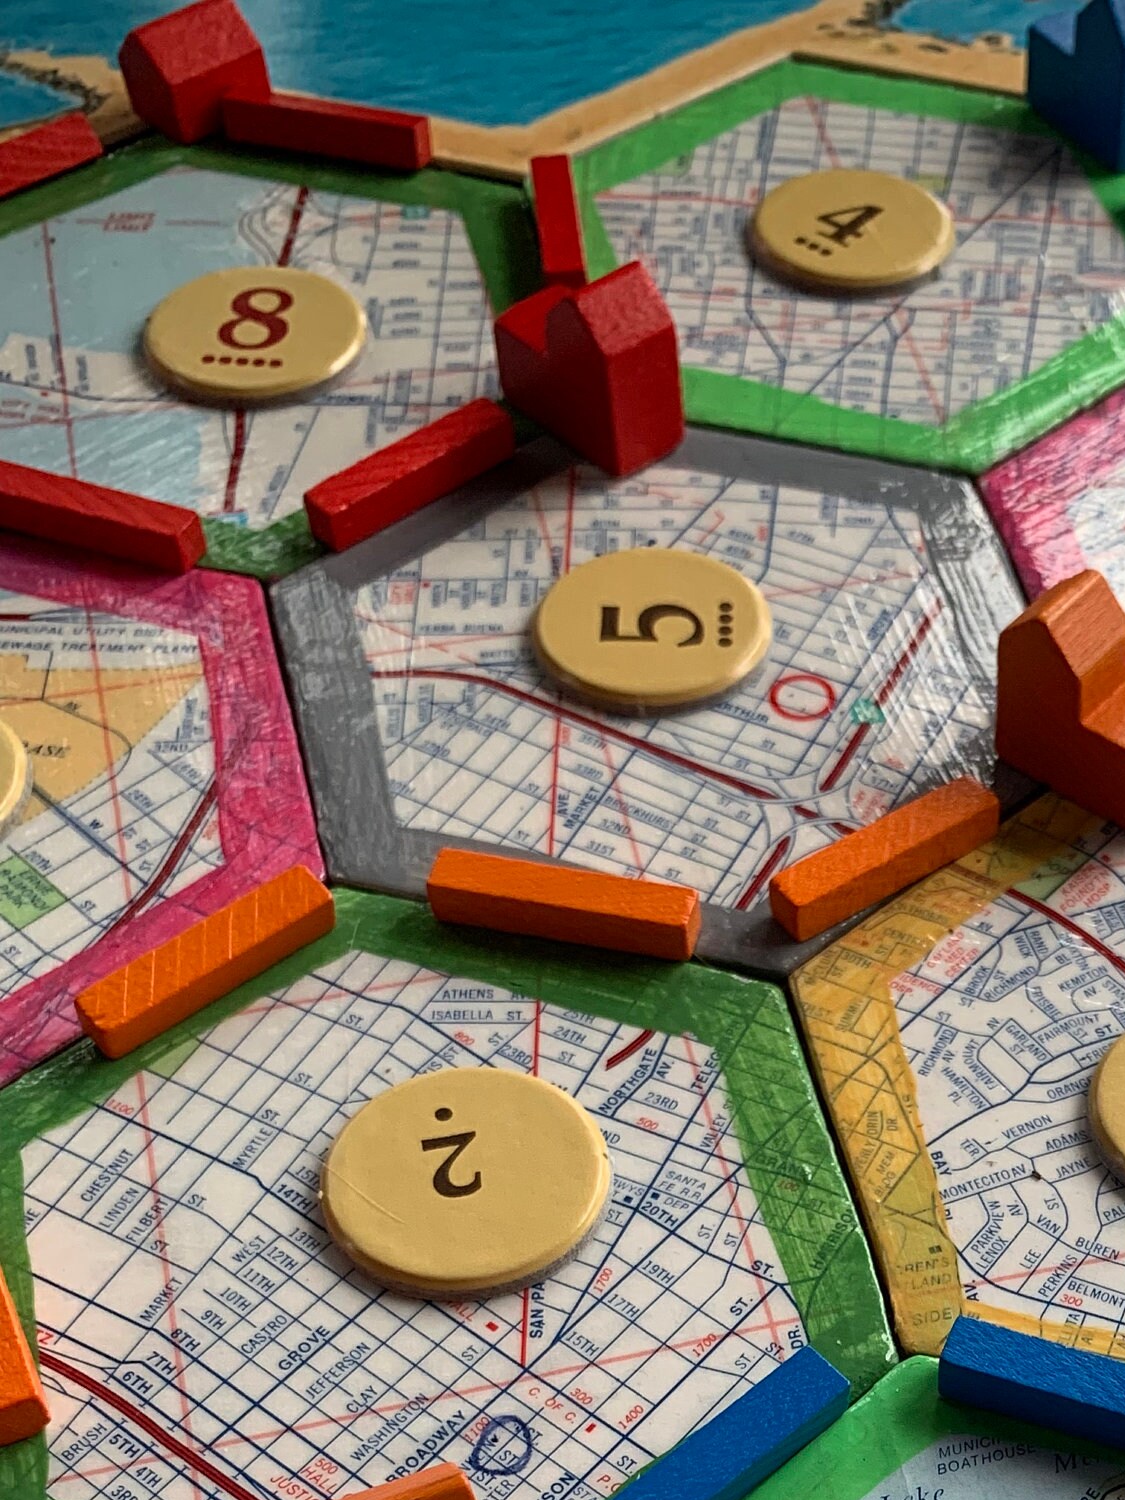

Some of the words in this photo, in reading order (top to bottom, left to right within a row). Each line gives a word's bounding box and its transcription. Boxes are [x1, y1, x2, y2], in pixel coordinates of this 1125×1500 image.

[816, 203, 886, 245] 4
[217, 288, 294, 350] 8
[72, 624, 125, 636] UTILITY
[599, 603, 705, 647] 5
[61, 643, 145, 654] TREATMENT
[150, 644, 199, 655] PLANT
[564, 787, 599, 830] MARKET
[441, 989, 494, 1000] ATHENS
[984, 965, 1036, 1002] RICHMOND
[431, 1009, 493, 1021] ISABELLA
[1005, 1025, 1047, 1062] GARLAND
[600, 1049, 656, 1113] NORTHGATE
[941, 1067, 986, 1111] HAMILTON
[106, 1099, 135, 1116] 1100
[636, 1117, 660, 1130] 500
[1003, 1115, 1051, 1140] VERNON
[233, 1125, 272, 1169] MYRTLE
[421, 1130, 482, 1198] 2
[81, 1149, 134, 1203] CHESTNUT
[940, 1169, 1010, 1199] MONTECITO
[101, 1188, 139, 1229] LINDEN
[127, 1199, 167, 1242] FILBERT
[640, 1200, 679, 1226] 20TH
[233, 1235, 266, 1263] WEST
[1036, 1215, 1061, 1234] VAN
[1076, 1236, 1120, 1260] BUREN
[1039, 1255, 1078, 1298] PERKINS
[139, 1277, 184, 1324] MARKET
[241, 1314, 288, 1355] CASTRO
[277, 1326, 331, 1371] GROVE
[306, 1342, 370, 1400] JEFFERSON
[347, 1385, 378, 1414] CLAY
[618, 1404, 645, 1430] 1400
[61, 1424, 107, 1462] BRUSH
[350, 1393, 429, 1462] WASHINGTON
[937, 1441, 1037, 1475] BOATHOUSE
